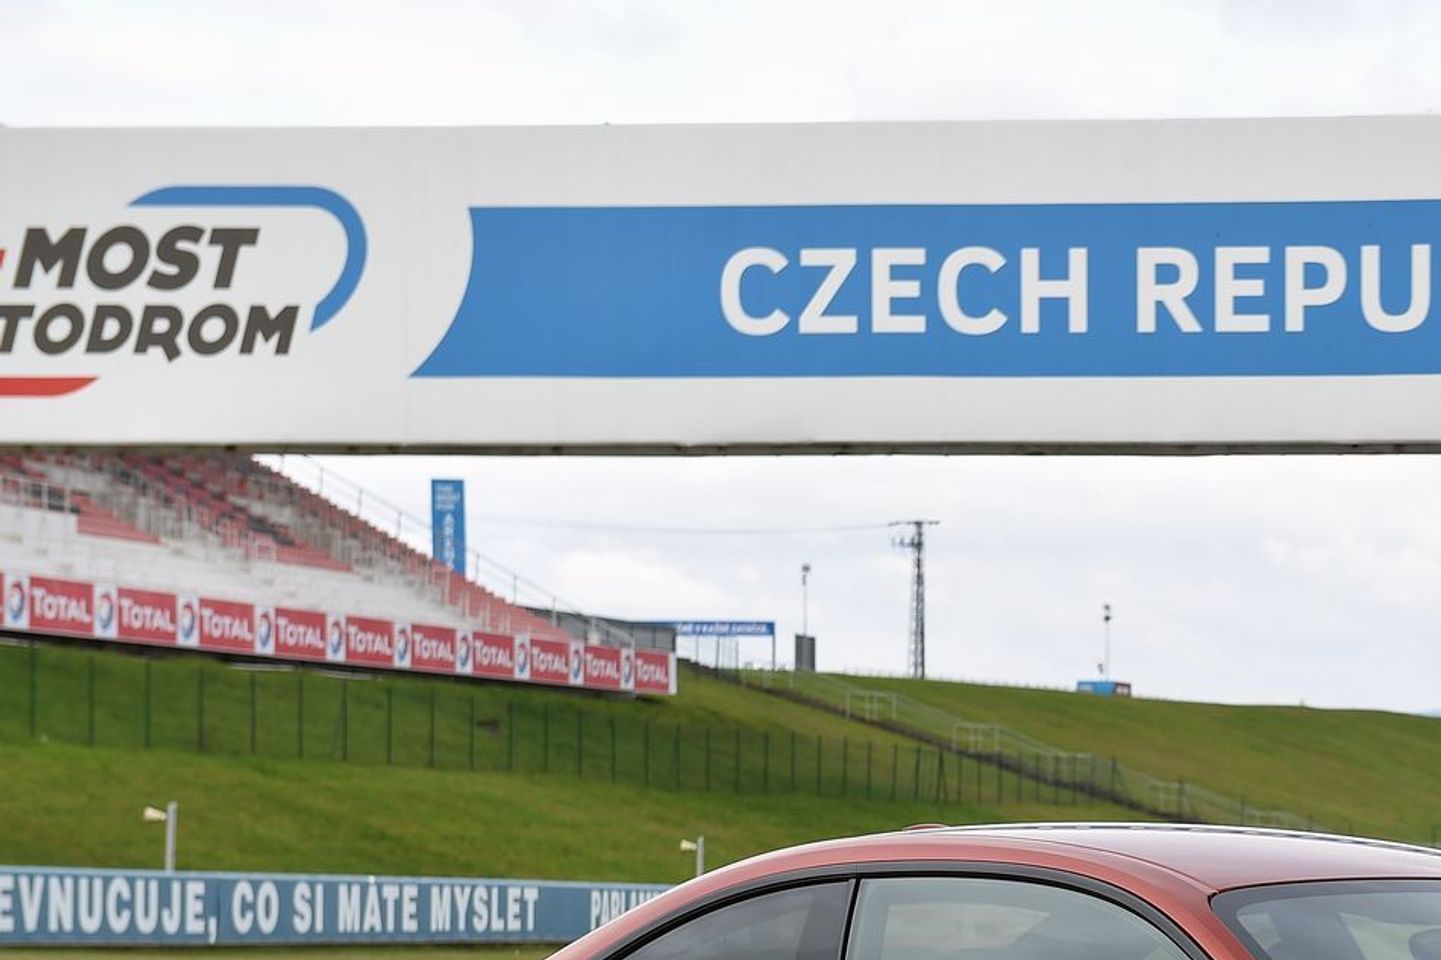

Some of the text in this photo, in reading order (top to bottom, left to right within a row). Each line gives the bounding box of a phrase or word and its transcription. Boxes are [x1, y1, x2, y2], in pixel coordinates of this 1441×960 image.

[13, 225, 260, 291] MOST
[719, 246, 1088, 336] CZECH
[0, 302, 300, 363] TODROM
[30, 588, 92, 623] TOTAL
[119, 599, 176, 632] TOTAL
[201, 606, 252, 642] TOTAL
[276, 618, 326, 646] TOTAL
[349, 625, 393, 655] TOTAL
[413, 634, 454, 661] TOTAL
[473, 640, 515, 666] TOTAL
[531, 647, 569, 672] TOTAL
[584, 652, 619, 678] TOTAL
[636, 656, 668, 683] TOTAL
[0, 875, 217, 944] EVNUCUJE,
[232, 880, 280, 934] CO
[293, 882, 325, 934] SI
[430, 885, 540, 933] MYSLET
